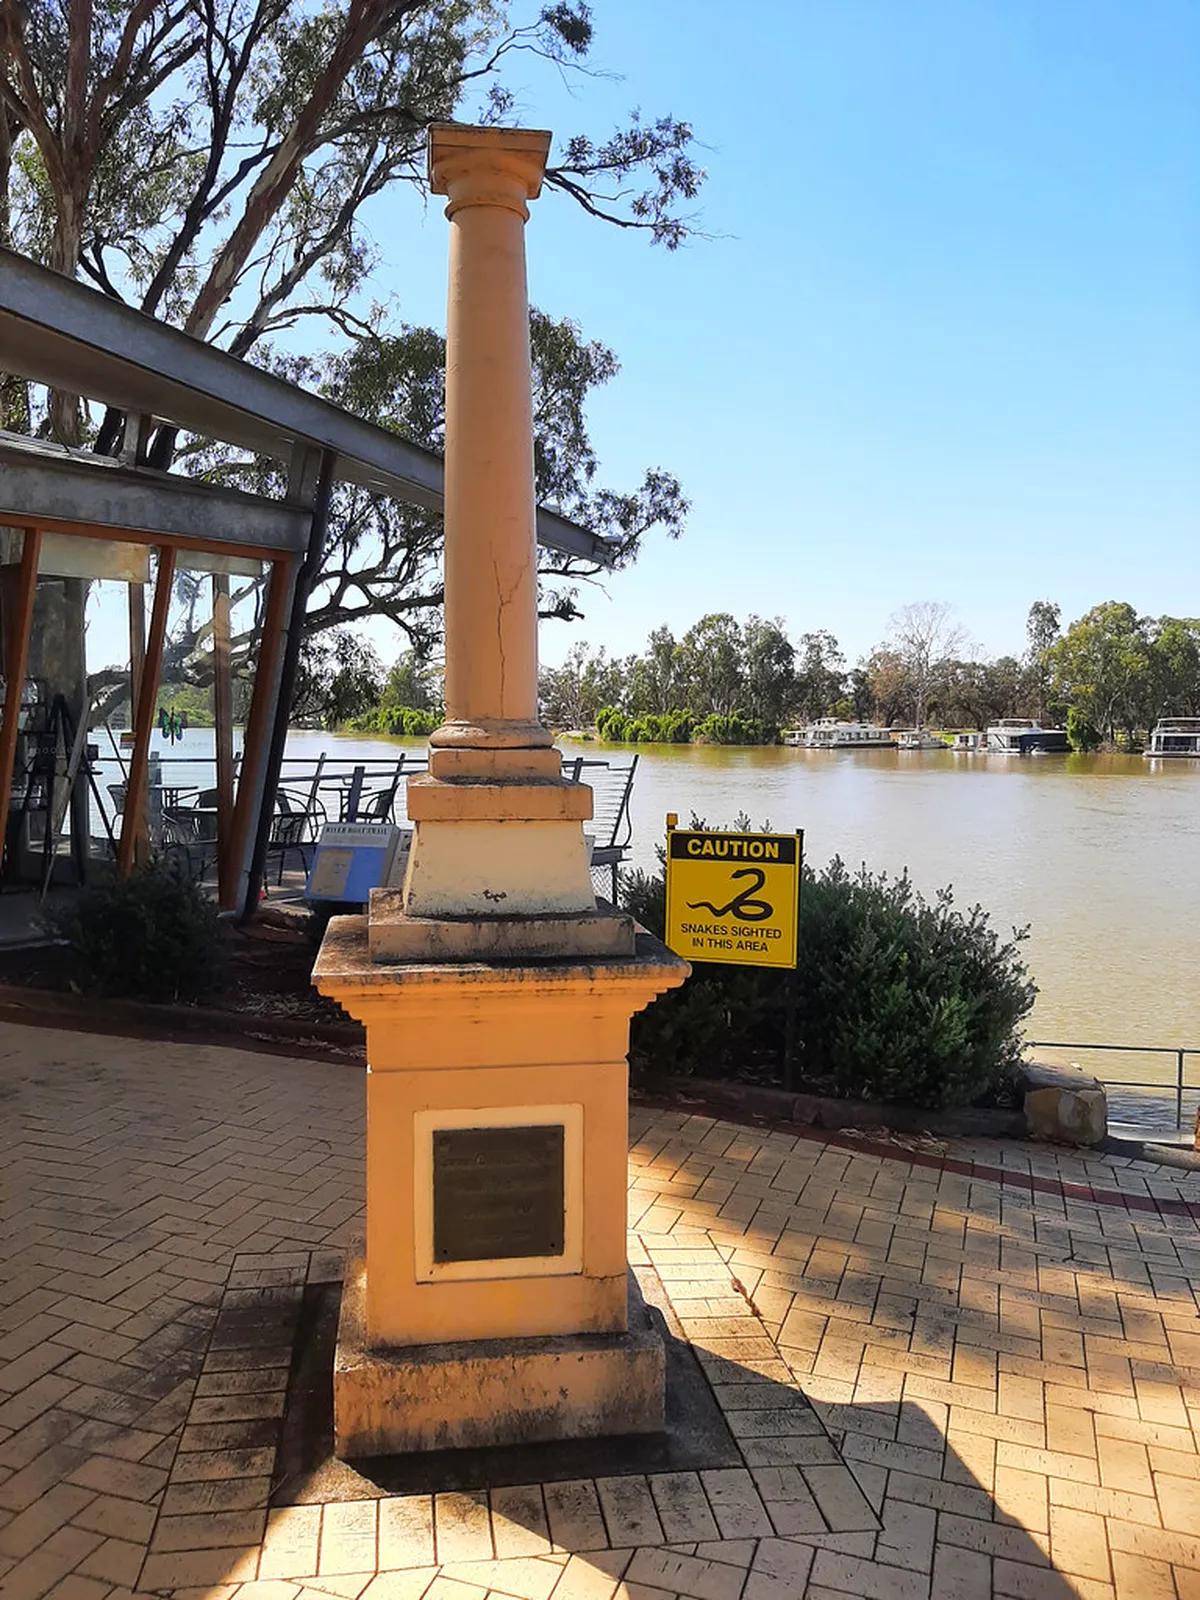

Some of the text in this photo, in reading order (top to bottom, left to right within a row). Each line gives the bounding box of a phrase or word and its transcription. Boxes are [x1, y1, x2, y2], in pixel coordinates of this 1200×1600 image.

[687, 839, 779, 858] CAUTION
[680, 923, 782, 939] SNAKES SIGHTED
[692, 938, 769, 952] IN THIS AREA
